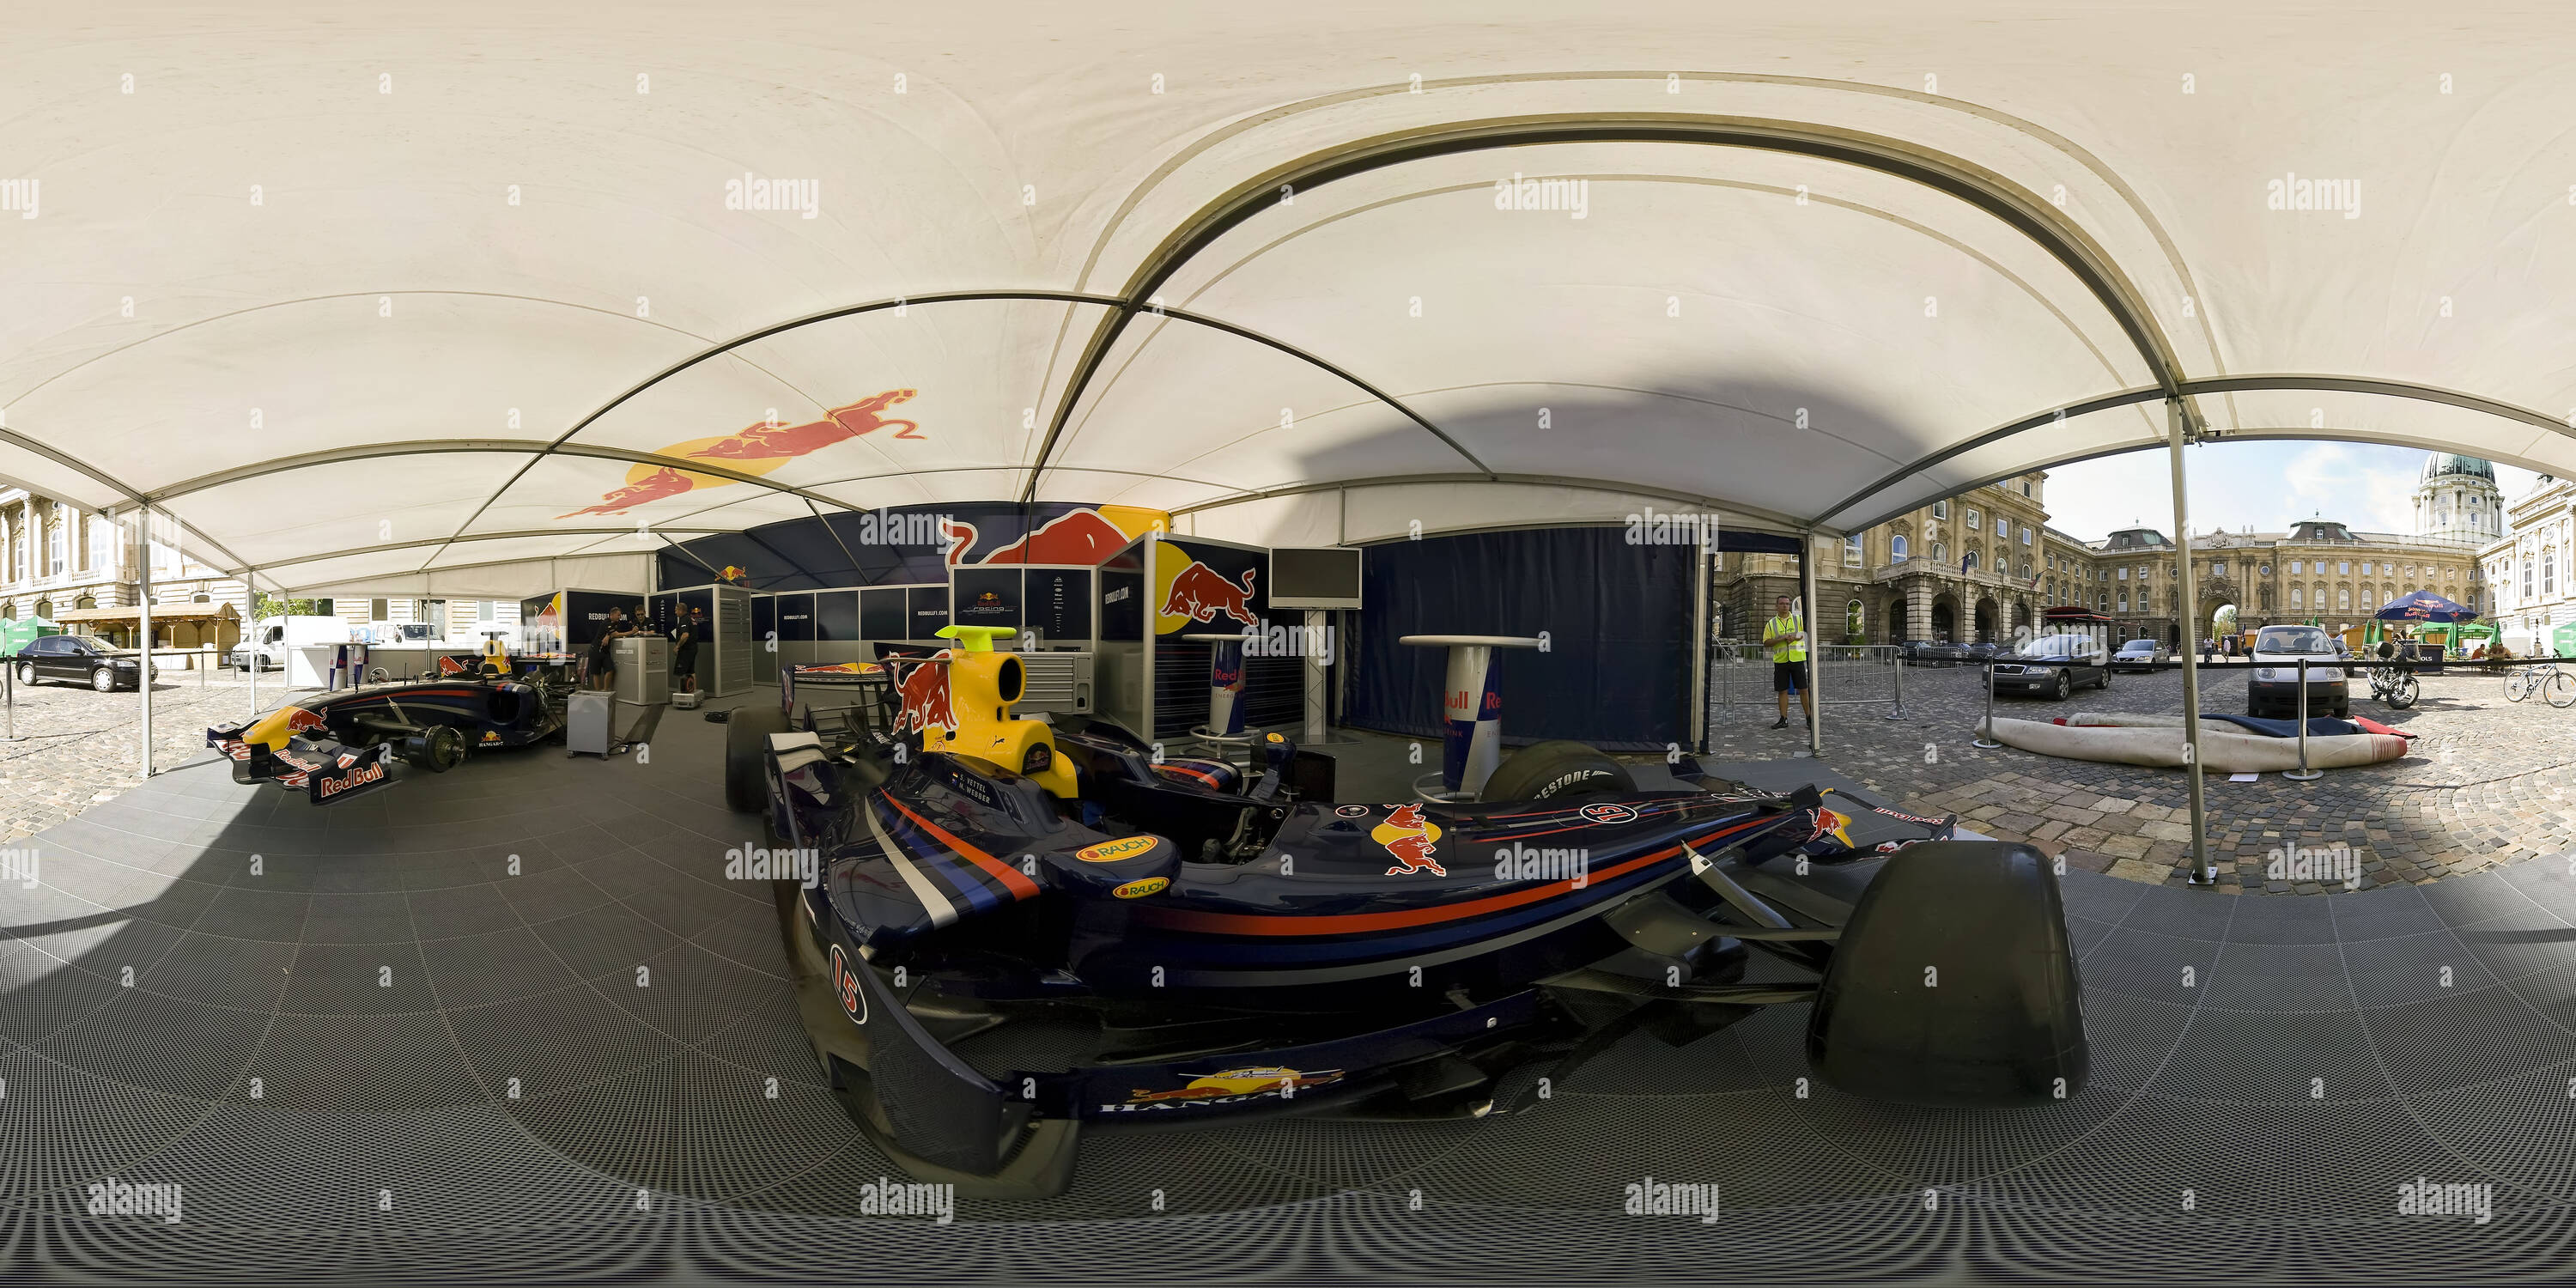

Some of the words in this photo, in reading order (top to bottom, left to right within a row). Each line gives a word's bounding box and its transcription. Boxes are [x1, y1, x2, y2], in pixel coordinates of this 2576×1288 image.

[1215, 669, 1236, 681] Red
[1486, 692, 1501, 709] Re
[275, 749, 295, 765] Red
[294, 758, 321, 772] Bull
[321, 769, 351, 798] Red
[353, 762, 384, 787] Bull
[959, 774, 965, 782] S.
[967, 776, 986, 793] VETTEL
[958, 782, 965, 791] M.
[966, 787, 990, 804] WEBBER
[1585, 805, 1631, 822] 15
[1874, 807, 1911, 819] Bull
[1097, 838, 1151, 857] RAUCH
[1129, 880, 1164, 896] RAUCH
[835, 950, 858, 1013] 15
